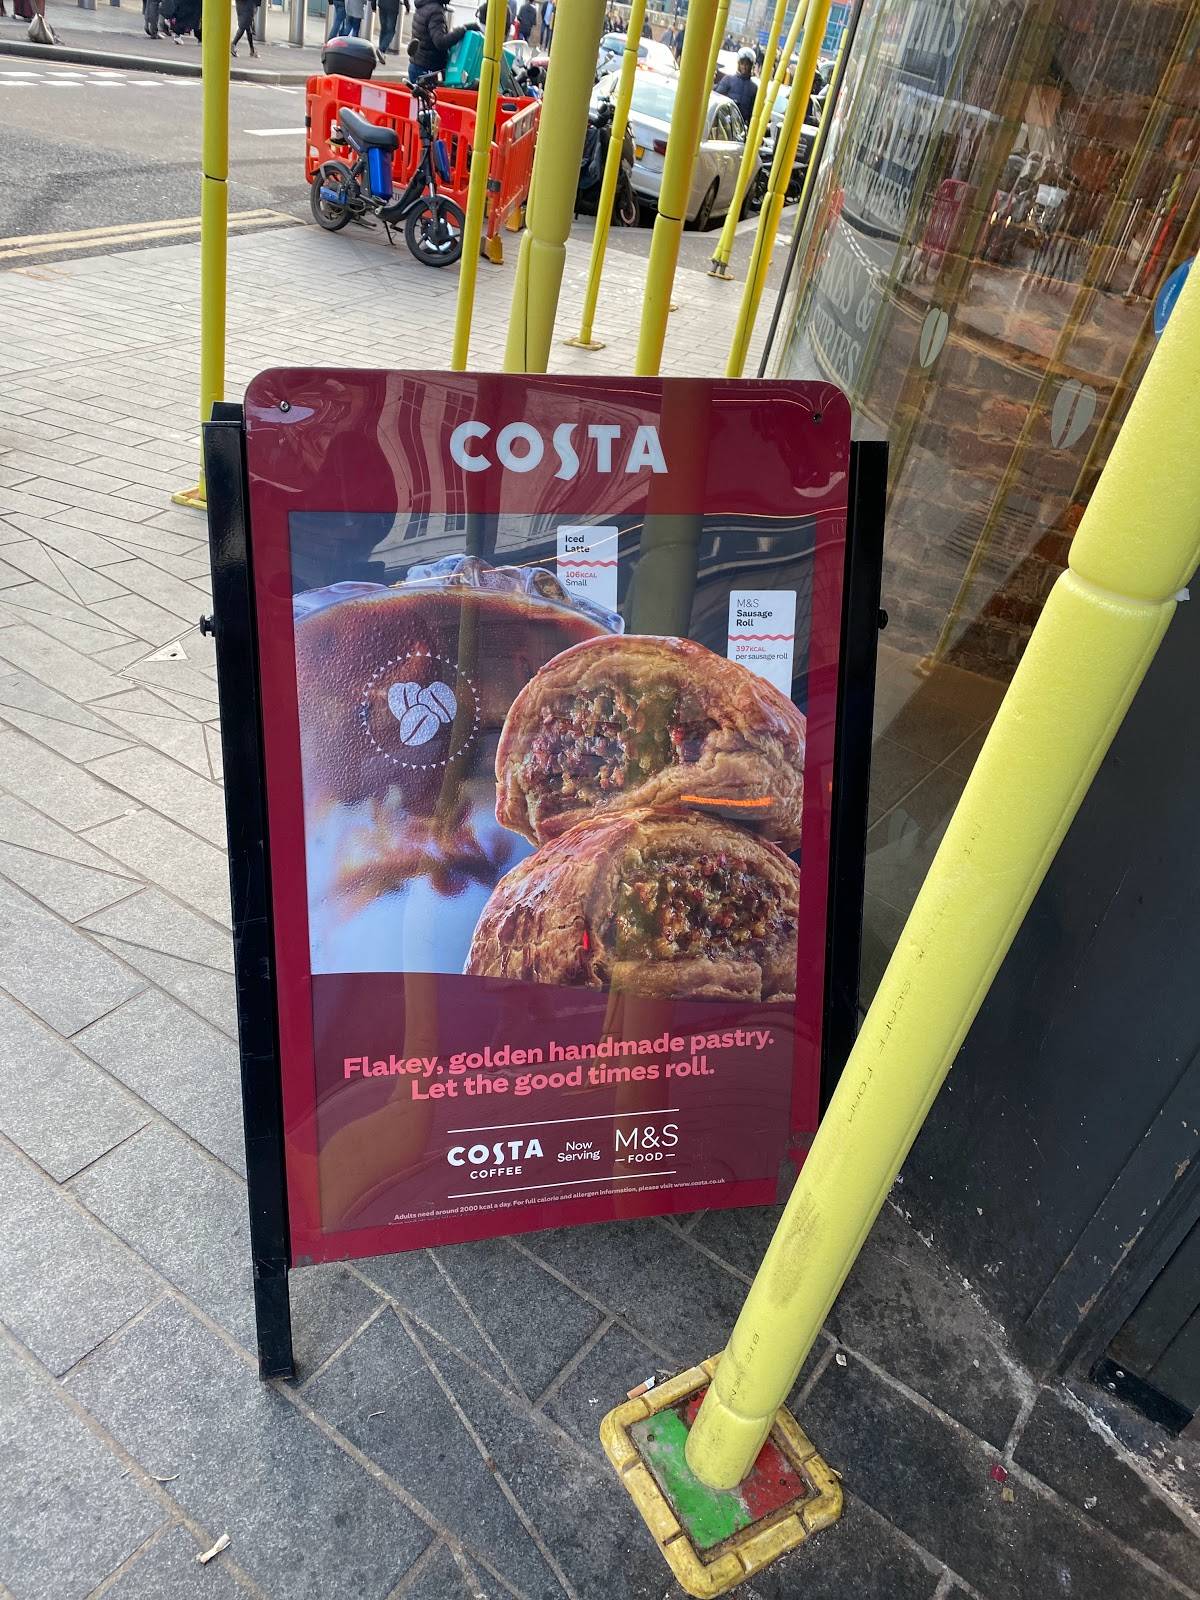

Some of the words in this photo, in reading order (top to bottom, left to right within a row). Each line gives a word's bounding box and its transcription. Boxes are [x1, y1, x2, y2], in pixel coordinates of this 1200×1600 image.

[450, 420, 669, 481] COSTA
[565, 534, 585, 543] Iced
[565, 544, 590, 553] Latte
[565, 579, 588, 587] Small
[736, 598, 759, 608] M&S
[736, 609, 773, 619] Sausage
[736, 619, 754, 627] Roll
[735, 654, 748, 662] per
[748, 653, 776, 662] sausage
[776, 652, 788, 660] roll
[343, 1054, 444, 1079] Flakey,
[448, 1044, 543, 1075] golden
[549, 1032, 685, 1063] handmade
[690, 1028, 775, 1055] pastry.
[411, 1078, 459, 1100] Let
[463, 1073, 509, 1096] the
[514, 1065, 582, 1096] good
[588, 1063, 660, 1086] times
[665, 1055, 715, 1078] roll.
[615, 1123, 680, 1152] M&S
[566, 1141, 593, 1151] Now
[447, 1138, 544, 1167] COSTA
[557, 1149, 600, 1163] Serving
[469, 1166, 523, 1180] COFFEE
[394, 1212, 417, 1221] Adults
[417, 1210, 435, 1218] need
[435, 1207, 459, 1216] around
[459, 1205, 478, 1213] 2000
[479, 1203, 493, 1211] kcal
[536, 1195, 559, 1204] calorie
[573, 1189, 599, 1199] allergen
[599, 1186, 638, 1196] information,
[638, 1184, 659, 1193] please
[660, 1182, 673, 1190] visit
[674, 1177, 726, 1189] www.costa.co.uk
